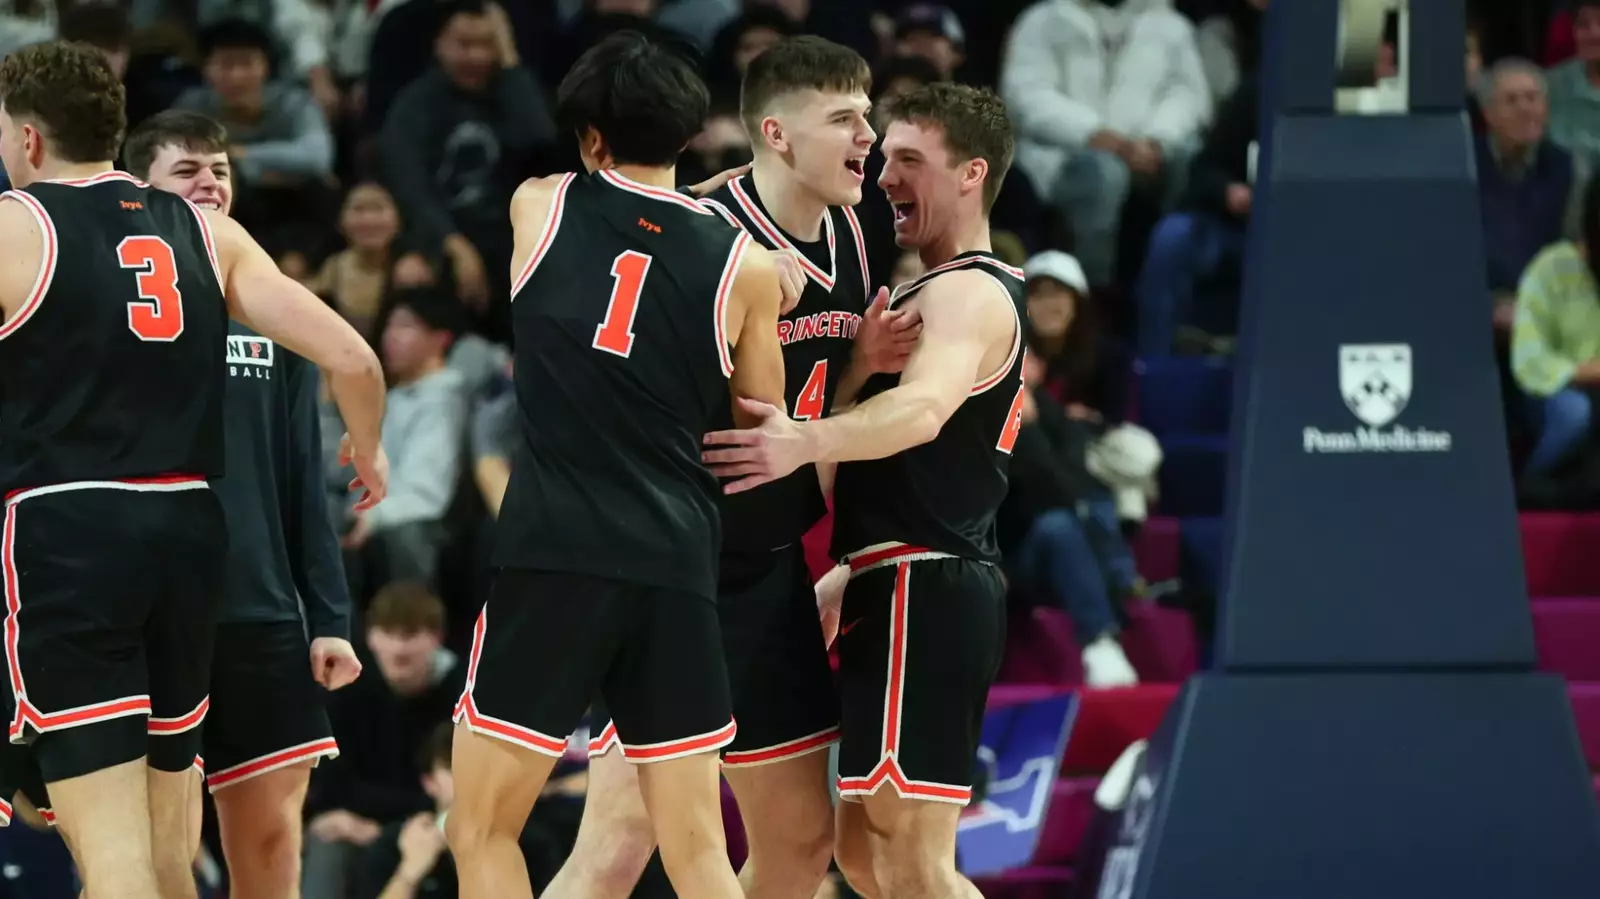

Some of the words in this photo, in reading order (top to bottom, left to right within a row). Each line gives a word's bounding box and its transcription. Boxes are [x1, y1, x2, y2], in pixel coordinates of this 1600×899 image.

[116, 235, 184, 342] 3
[592, 249, 652, 358] 1
[777, 310, 862, 346] RINCETO
[793, 358, 828, 421] 4
[1303, 426, 1354, 453] Penn
[1354, 424, 1452, 452] Medicine
